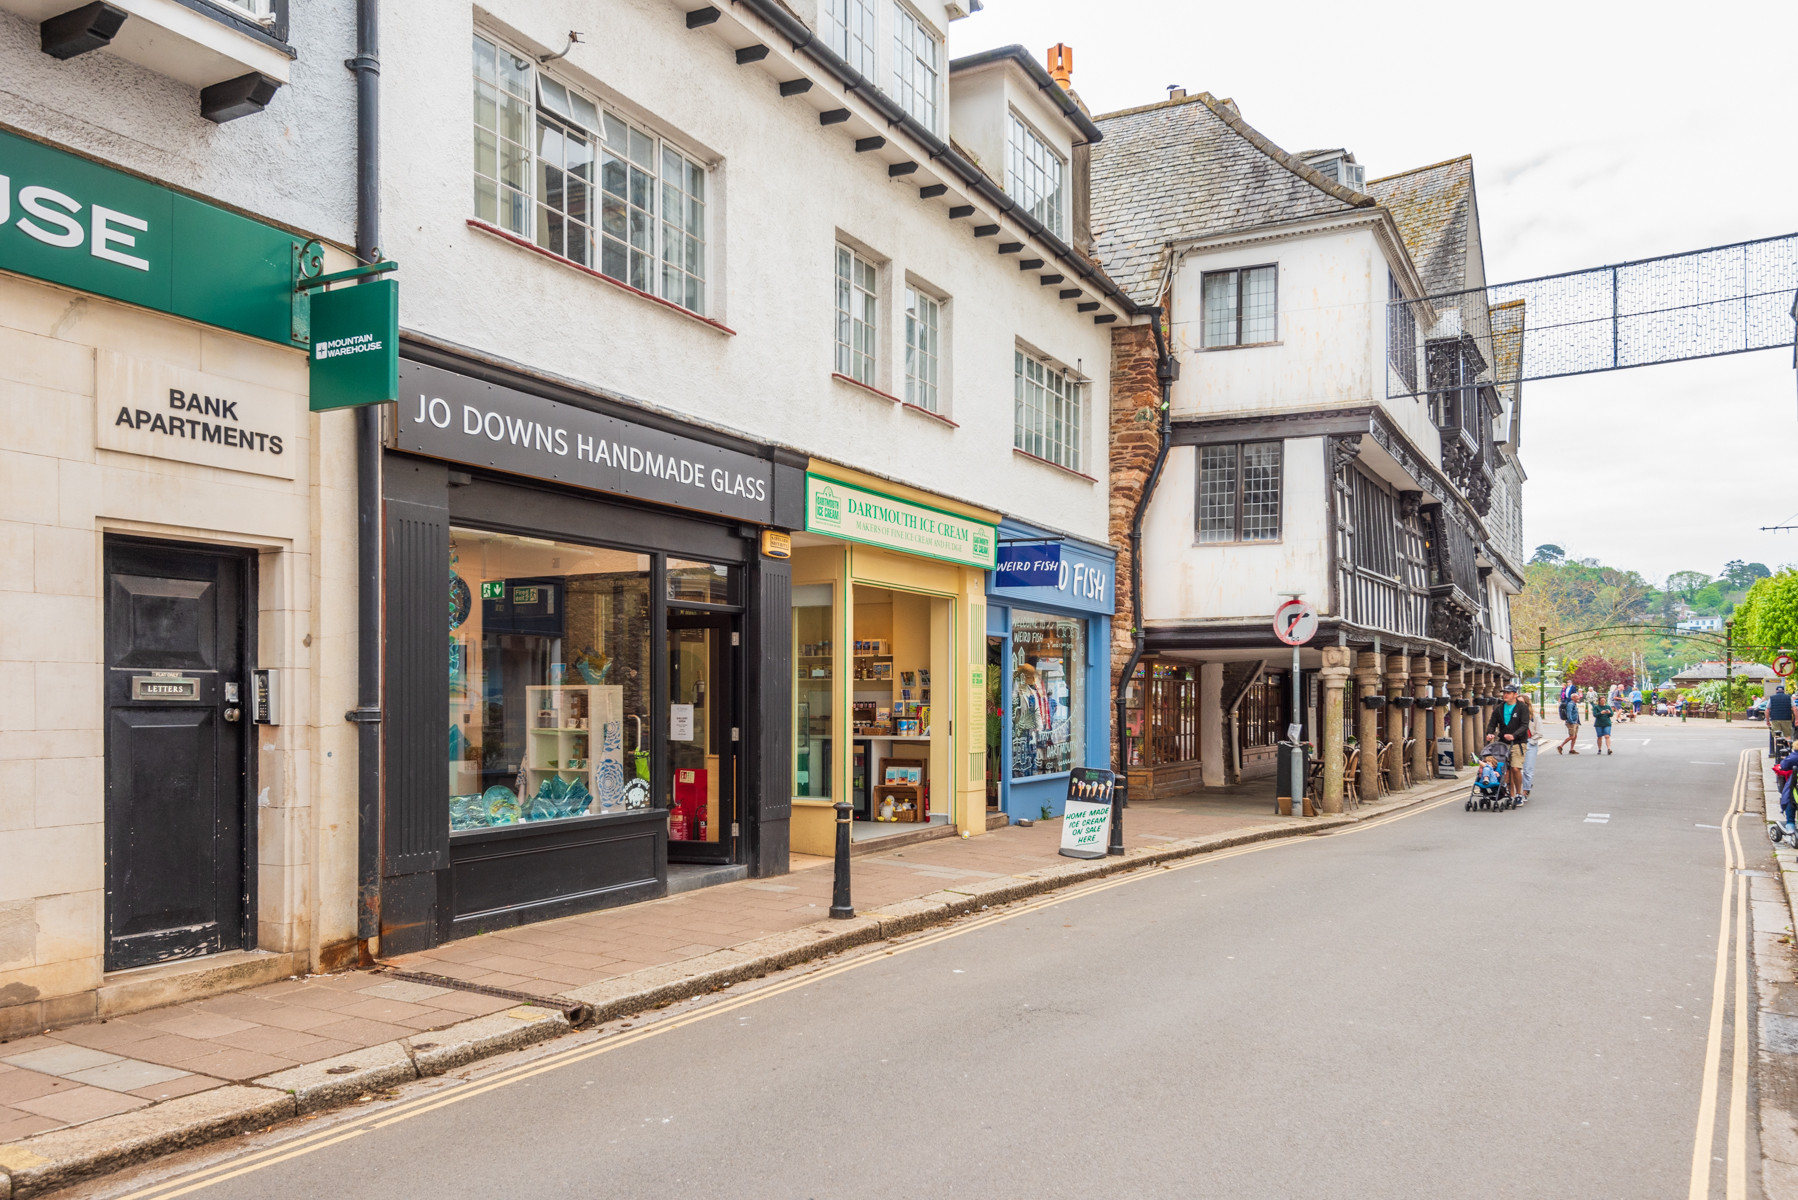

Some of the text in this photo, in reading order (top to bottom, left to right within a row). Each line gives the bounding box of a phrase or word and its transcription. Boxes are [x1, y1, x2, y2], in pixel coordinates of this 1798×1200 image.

[327, 333, 373, 348] MOUNTAIN
[327, 340, 382, 358] WAREHOUSE
[168, 388, 238, 421] BANK
[115, 406, 284, 455] APARTMENTS
[414, 394, 766, 503] JO DOWNS HANDMADE GLASS
[824, 508, 840, 520] CREAM
[848, 498, 968, 542] DARTMOUTH ICE CREAM
[856, 520, 962, 552] MAKERS OF FINE ICE CREAM AND FUDGE
[996, 560, 1059, 573] WEIRD FISH
[1073, 562, 1106, 602] FISH
[1014, 631, 1044, 643] WEIRD FISH
[1065, 807, 1110, 820] HOME MADE
[1069, 817, 1107, 828] ICE CREAM
[1072, 825, 1102, 836] ON SALE
[1078, 834, 1096, 844] HERE
